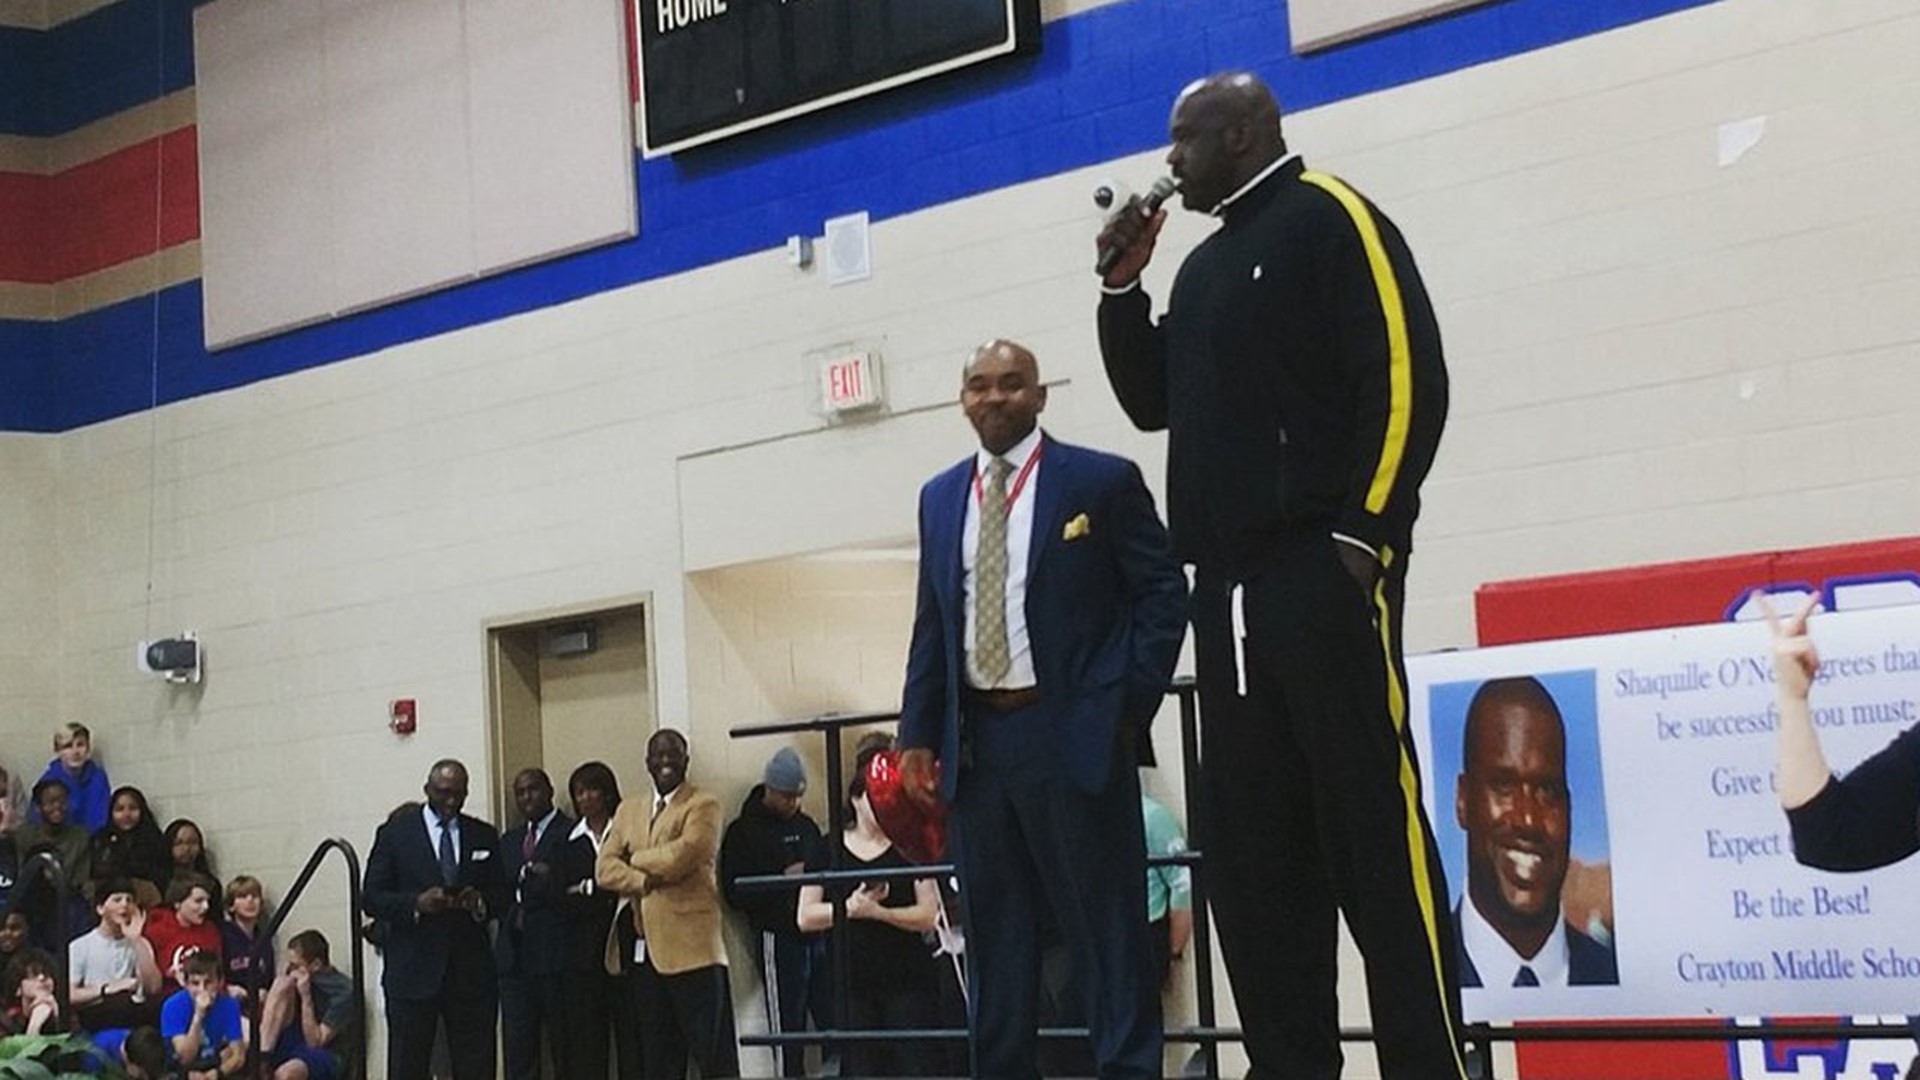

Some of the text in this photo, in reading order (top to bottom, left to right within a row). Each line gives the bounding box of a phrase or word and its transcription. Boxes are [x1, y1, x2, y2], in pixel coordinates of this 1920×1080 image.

[829, 360, 862, 401] EXIT
[1614, 644, 1920, 700] Shaquille O'Ne grees tha
[1656, 712, 1682, 740] be
[1689, 702, 1780, 738] successf
[1852, 699, 1917, 725] must:
[1711, 767, 1762, 797] Give
[1706, 829, 1783, 865] Expect
[1733, 885, 1871, 919] Be the Best!
[1677, 946, 1920, 989] Crayton Middle Scho
